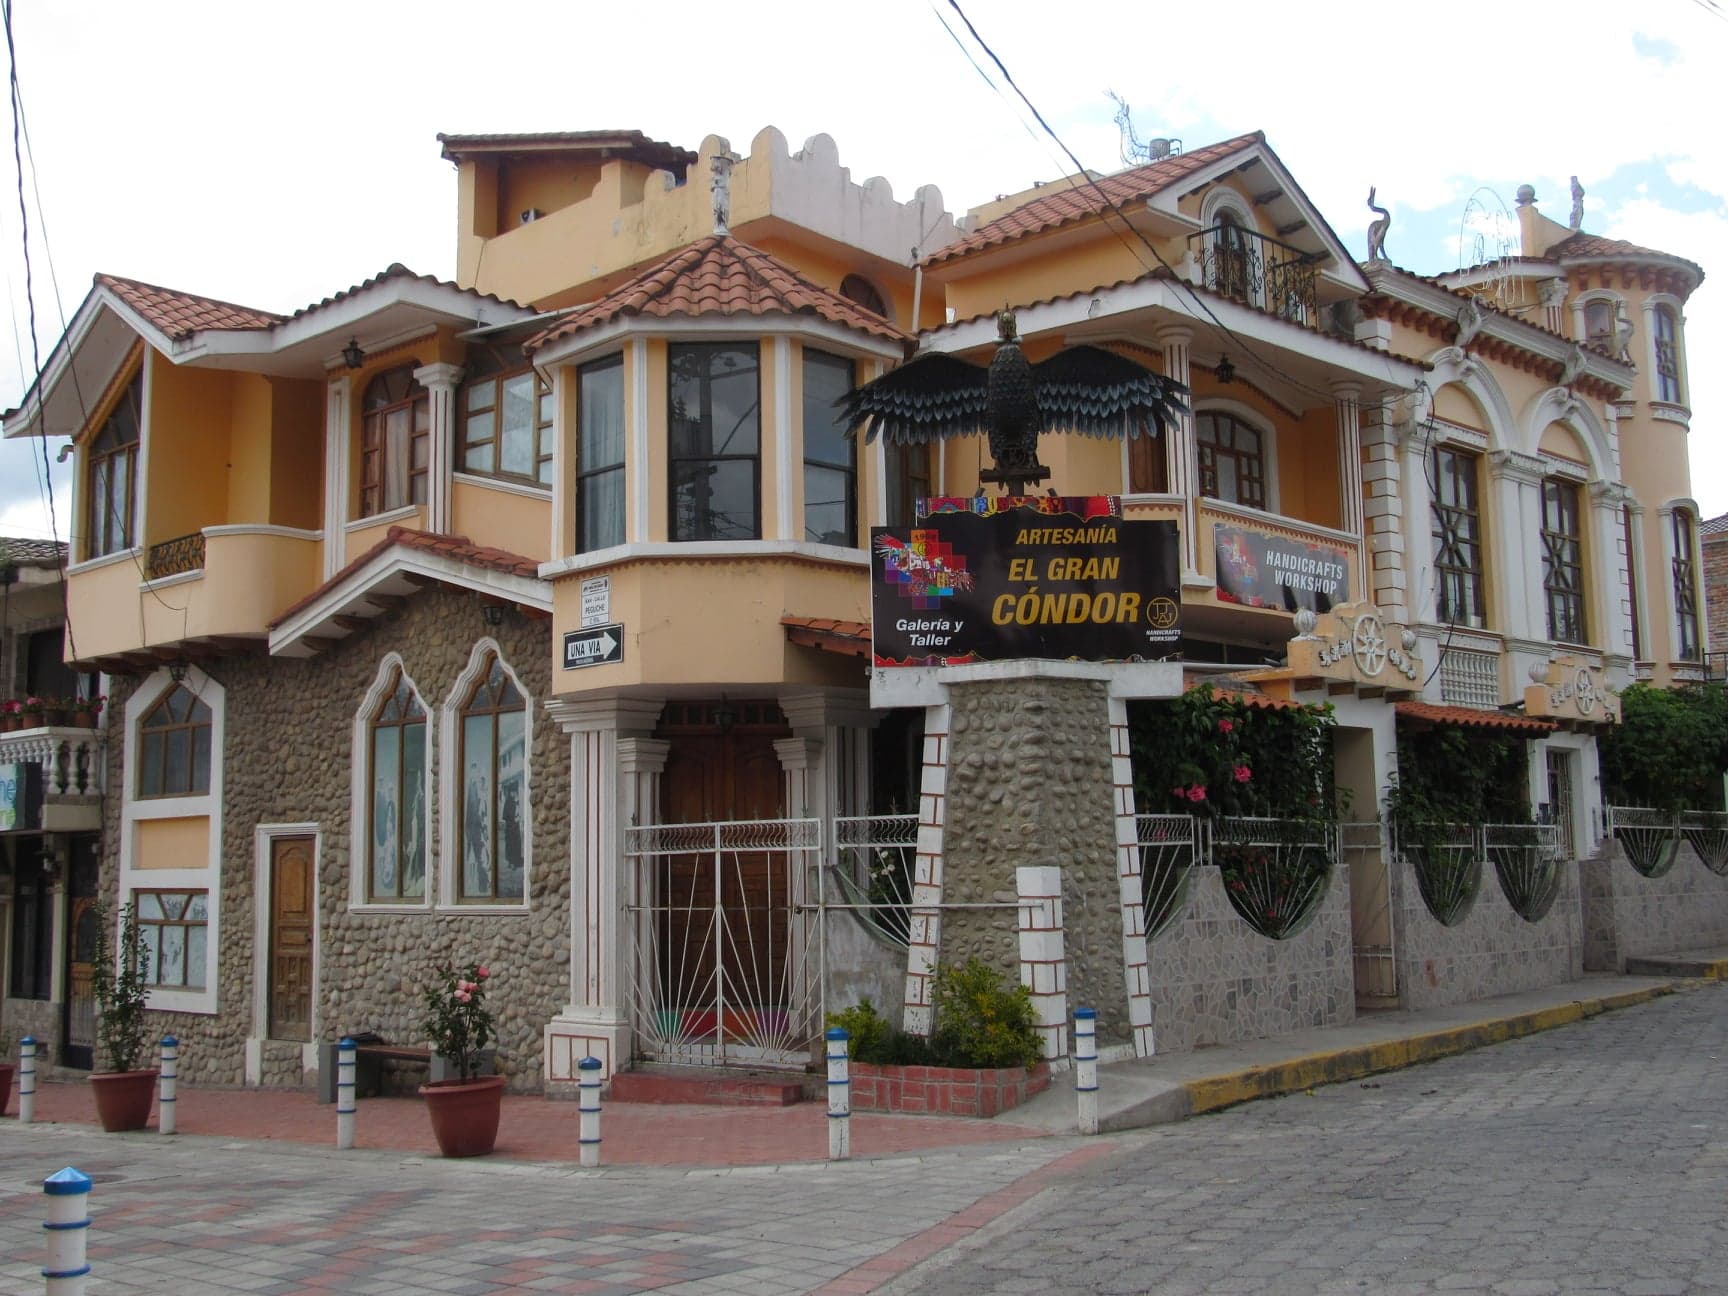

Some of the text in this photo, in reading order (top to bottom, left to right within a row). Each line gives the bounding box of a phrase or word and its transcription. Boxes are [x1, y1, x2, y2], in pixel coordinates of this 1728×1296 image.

[1016, 526, 1118, 545] ARTESANÍA
[1008, 557, 1120, 582] EL GRAN
[1266, 550, 1343, 579] HANDICRAFTS
[1274, 570, 1337, 594] WORKSHOP
[992, 587, 1142, 626] CÓNDOR
[896, 619, 964, 634] Galería y
[571, 640, 601, 658] UNA VIA
[909, 634, 952, 647] Taller
